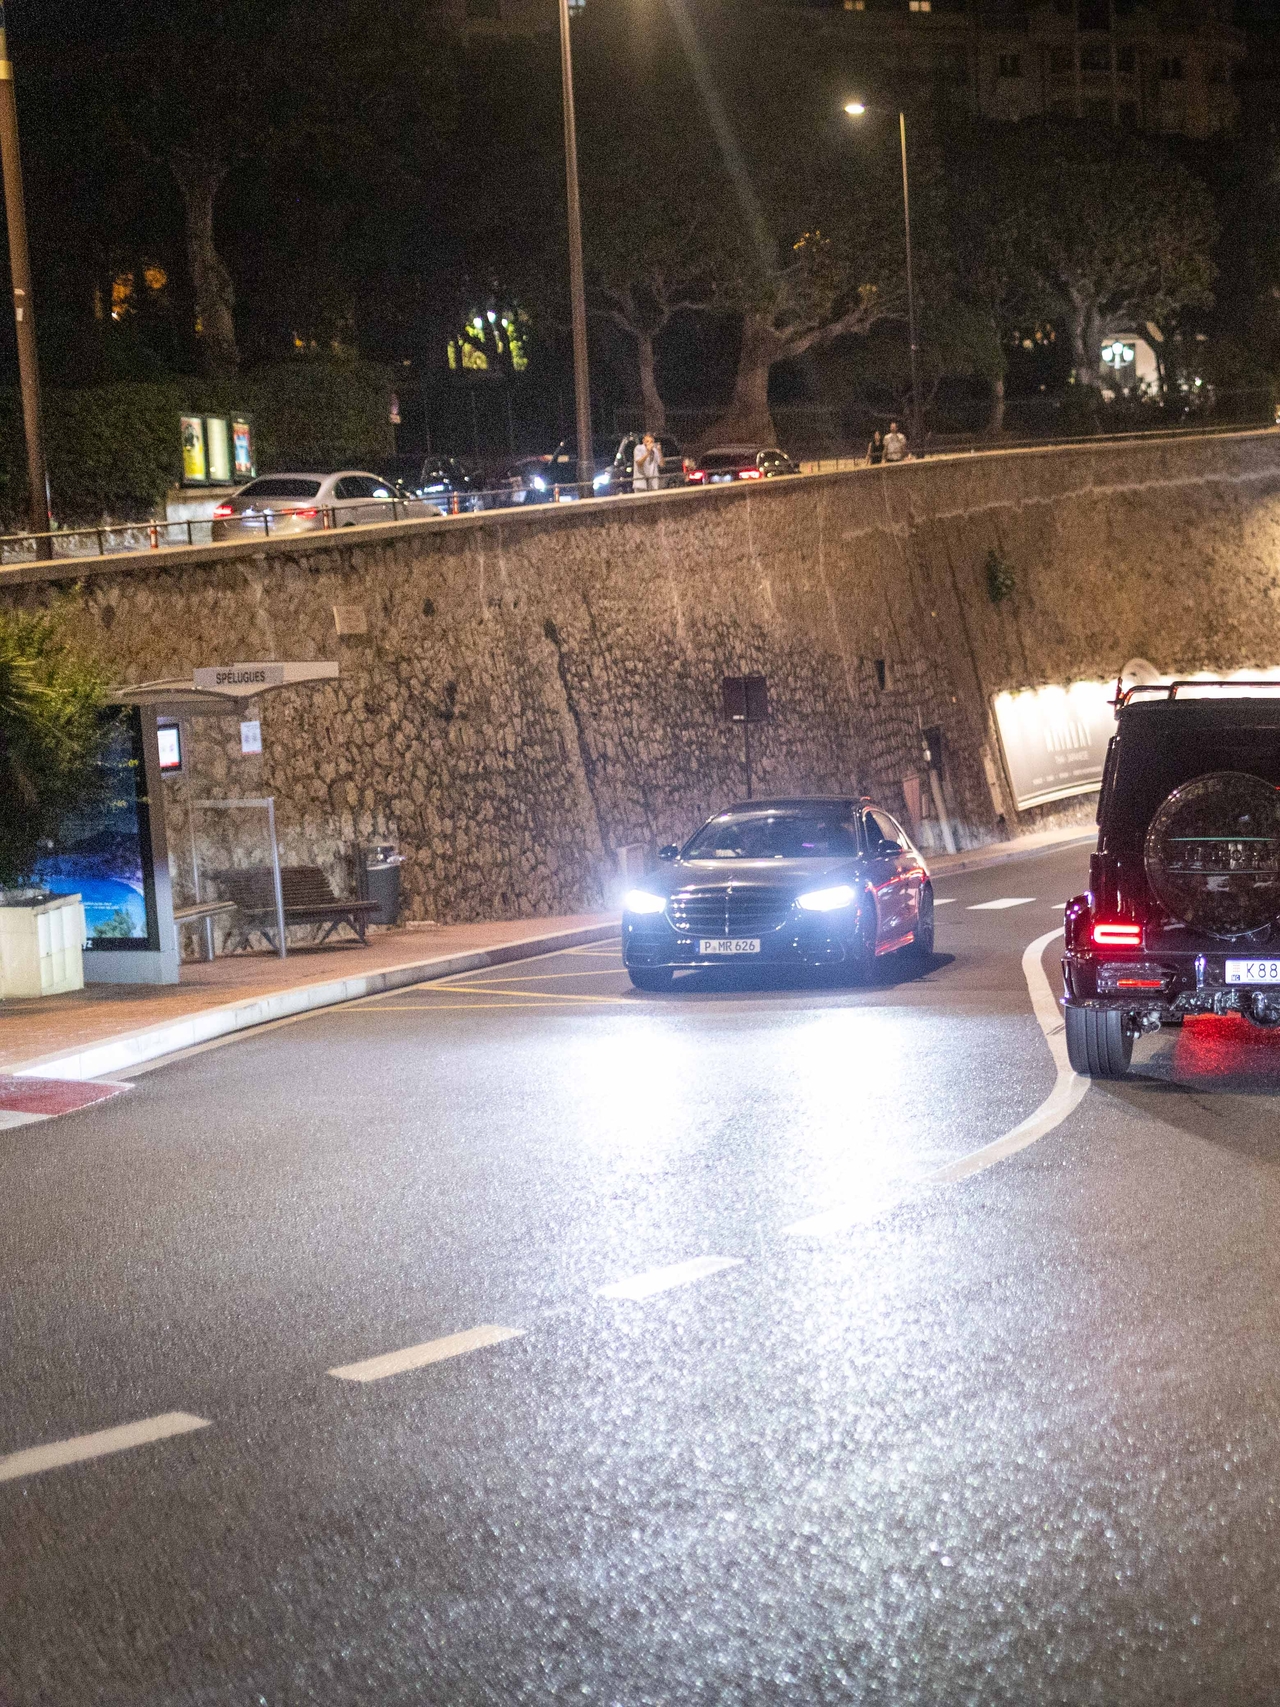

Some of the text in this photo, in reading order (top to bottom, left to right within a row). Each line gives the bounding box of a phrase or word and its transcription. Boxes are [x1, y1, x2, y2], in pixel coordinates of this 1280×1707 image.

[216, 669, 266, 685] SPÉLUGUES
[704, 940, 756, 952] P MR 626
